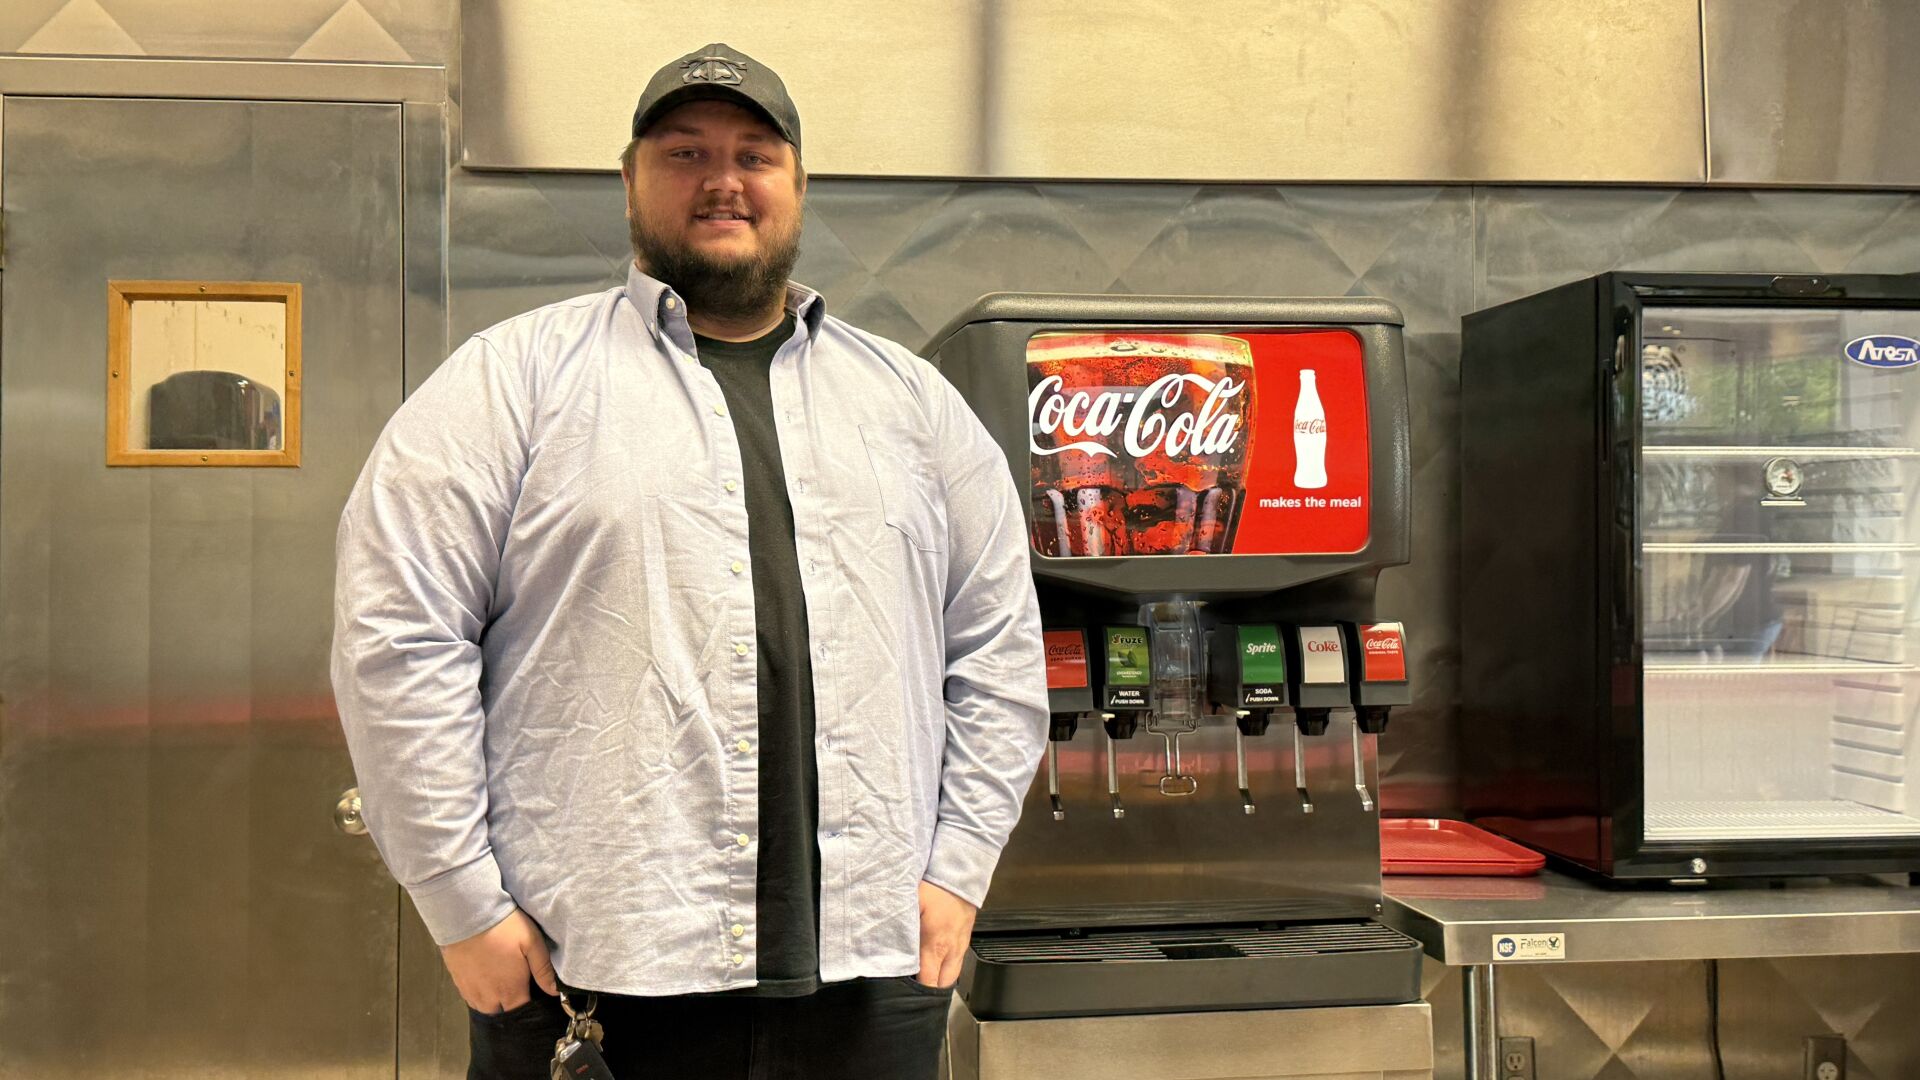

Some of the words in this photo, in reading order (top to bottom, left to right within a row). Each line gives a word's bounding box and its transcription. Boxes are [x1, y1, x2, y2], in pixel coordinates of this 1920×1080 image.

[1028, 373, 1246, 458] Coca-Cola
[1259, 496, 1302, 508] makes
[1305, 496, 1327, 508] the
[1330, 495, 1362, 508] meal
[1120, 636, 1143, 645] FUZE
[1307, 639, 1339, 653] Coke
[1365, 637, 1400, 650] Coca-Cola
[1246, 641, 1277, 656] Sprite
[1520, 938, 1547, 950] Falcon
